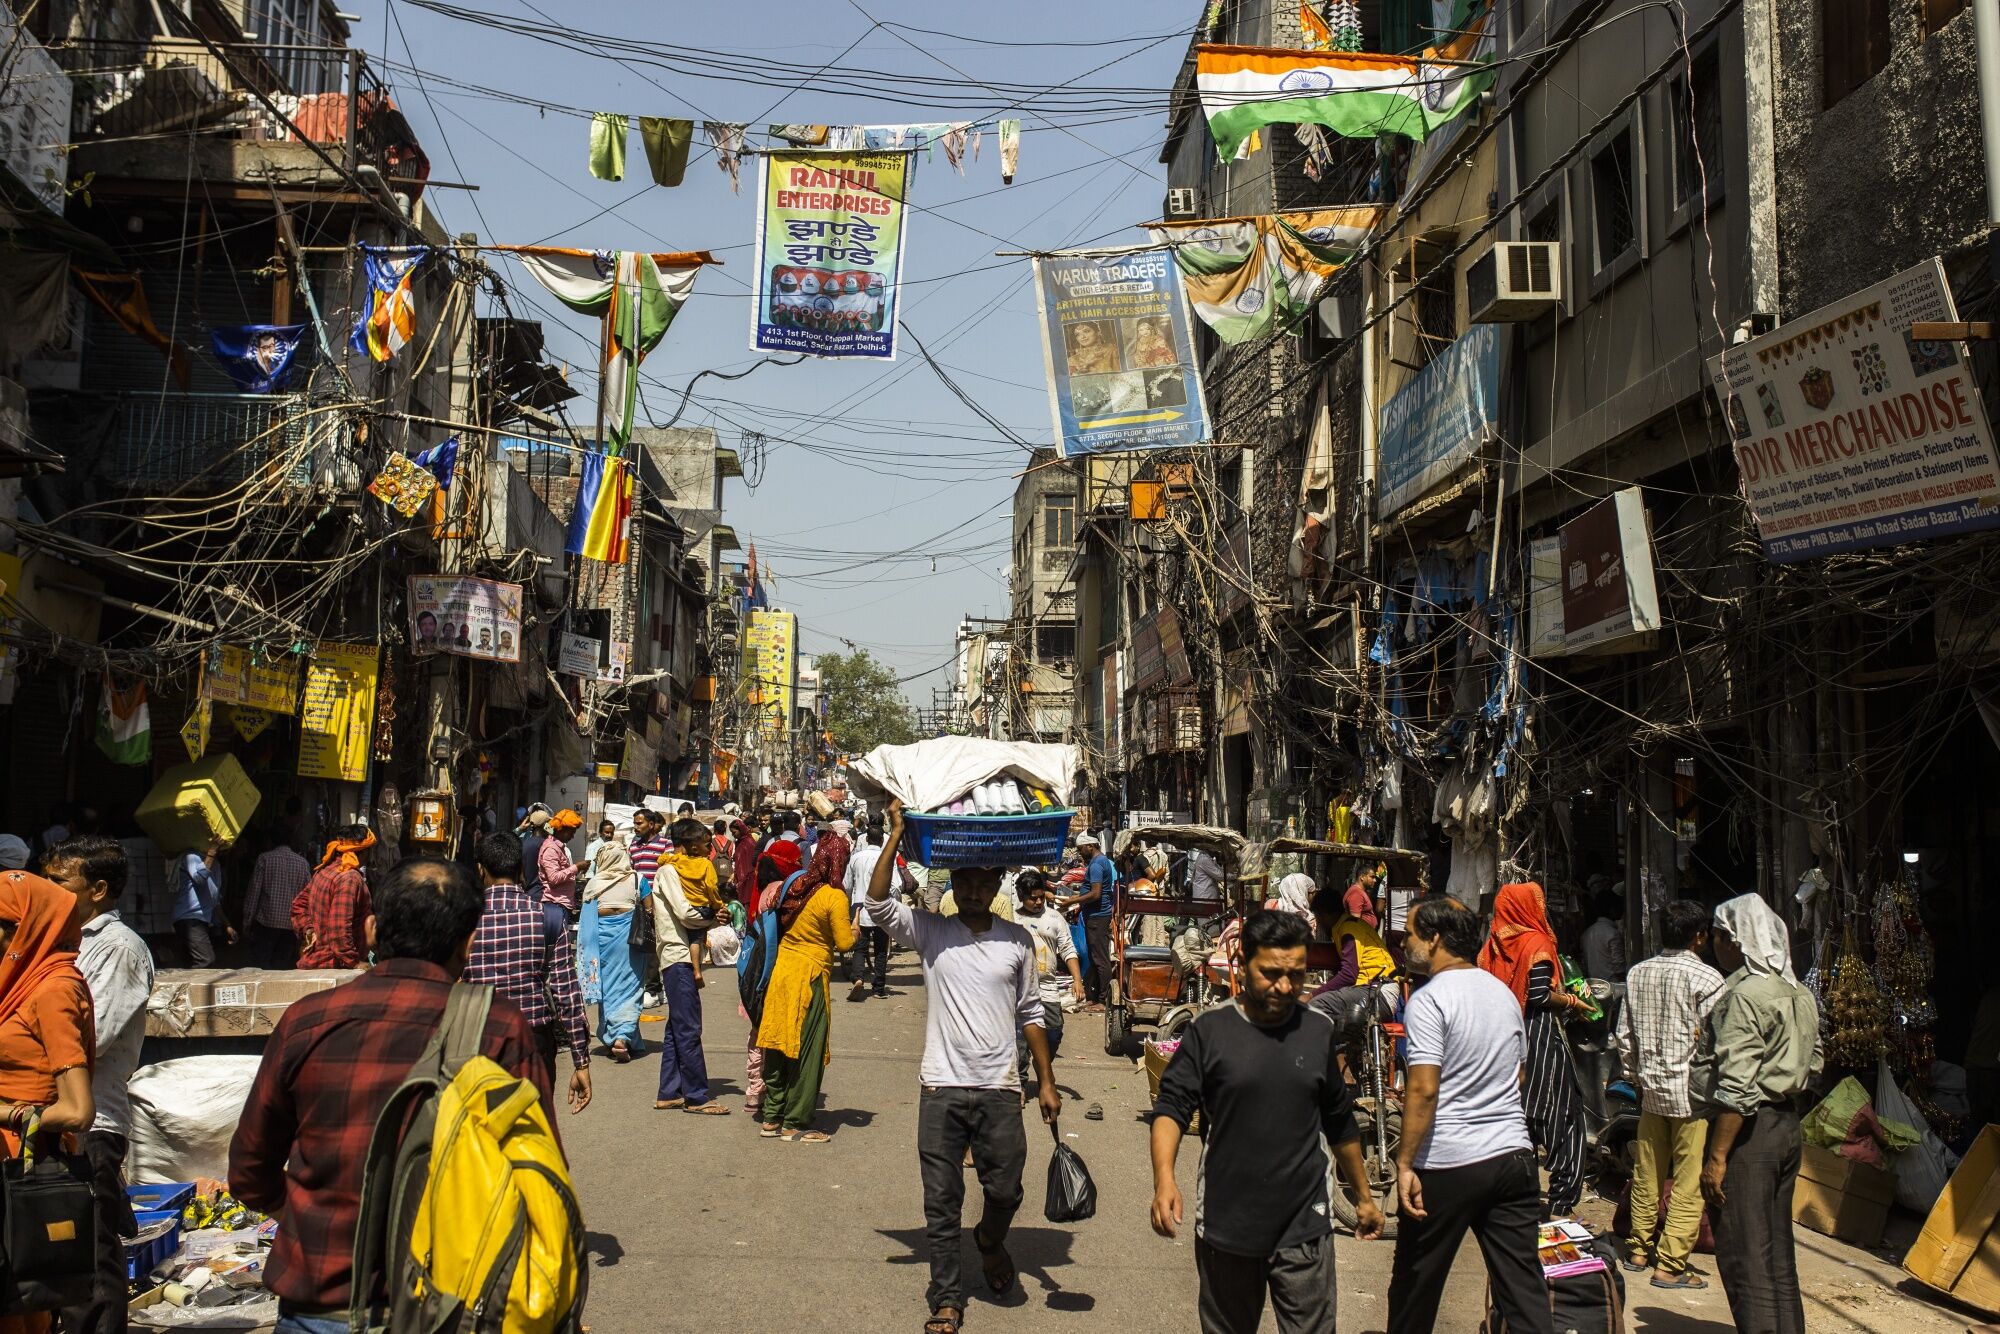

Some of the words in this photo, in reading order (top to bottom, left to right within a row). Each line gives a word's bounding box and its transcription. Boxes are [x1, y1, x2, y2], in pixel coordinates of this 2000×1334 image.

[855, 160, 901, 171] 9999457317
[790, 167, 880, 192] RAHUL
[776, 190, 892, 216] ENTERPRISES
[1102, 262, 1166, 281] TRADERS
[1072, 285, 1118, 296] WHOLESALE
[1126, 283, 1151, 292] RETAIL
[1056, 298, 1108, 311] ARTIFICIAL
[1110, 292, 1160, 306] JEWELLERY
[1164, 292, 1171, 301] &
[1060, 312, 1077, 321] ALL
[1080, 309, 1103, 319] HAIR
[1106, 304, 1168, 317] ACCESSORIES
[762, 336, 783, 345] Main
[785, 338, 809, 348] Road,
[811, 341, 832, 350] Sadar
[857, 343, 887, 351] Delhi-6
[766, 328, 784, 337] 413,
[787, 329, 799, 337] 1st
[801, 331, 823, 341] Floor,
[855, 334, 884, 342] Market
[1728, 363, 1751, 378] Mukesh
[1785, 376, 1975, 472] MERCHANDISE
[1097, 432, 1122, 440] SECOND
[1752, 488, 1768, 500] Deals
[1780, 483, 1788, 493] All
[1788, 479, 1807, 493] Types
[1807, 476, 1814, 486] of
[1814, 471, 1843, 485] Stickers,
[1843, 463, 1863, 477] Photo
[1863, 456, 1889, 473] Printed
[1889, 449, 1924, 466] Pictures,
[1923, 441, 1953, 457] Picture
[1954, 433, 1981, 450] Chart,
[1801, 493, 1813, 506] Gift
[1814, 491, 1835, 504] Paper,
[1834, 486, 1853, 500] Toys,
[1852, 478, 1875, 494] Diwali
[1875, 470, 1914, 488] Decoration
[1914, 467, 1922, 480] &
[1922, 460, 1964, 477] Stationery
[1963, 454, 1989, 469] Items
[1922, 482, 1955, 501] WHOLESALE
[1954, 474, 1997, 494] MERCHANDISE
[1791, 538, 1810, 550] Near
[1810, 532, 1828, 546] PNB
[1828, 528, 1854, 543] Bank,
[1853, 523, 1876, 540] Main
[1876, 519, 1900, 536] Road
[1900, 515, 1928, 530] Sadar
[1929, 510, 1961, 525] Bazar,
[345, 645, 377, 656] FOODS
